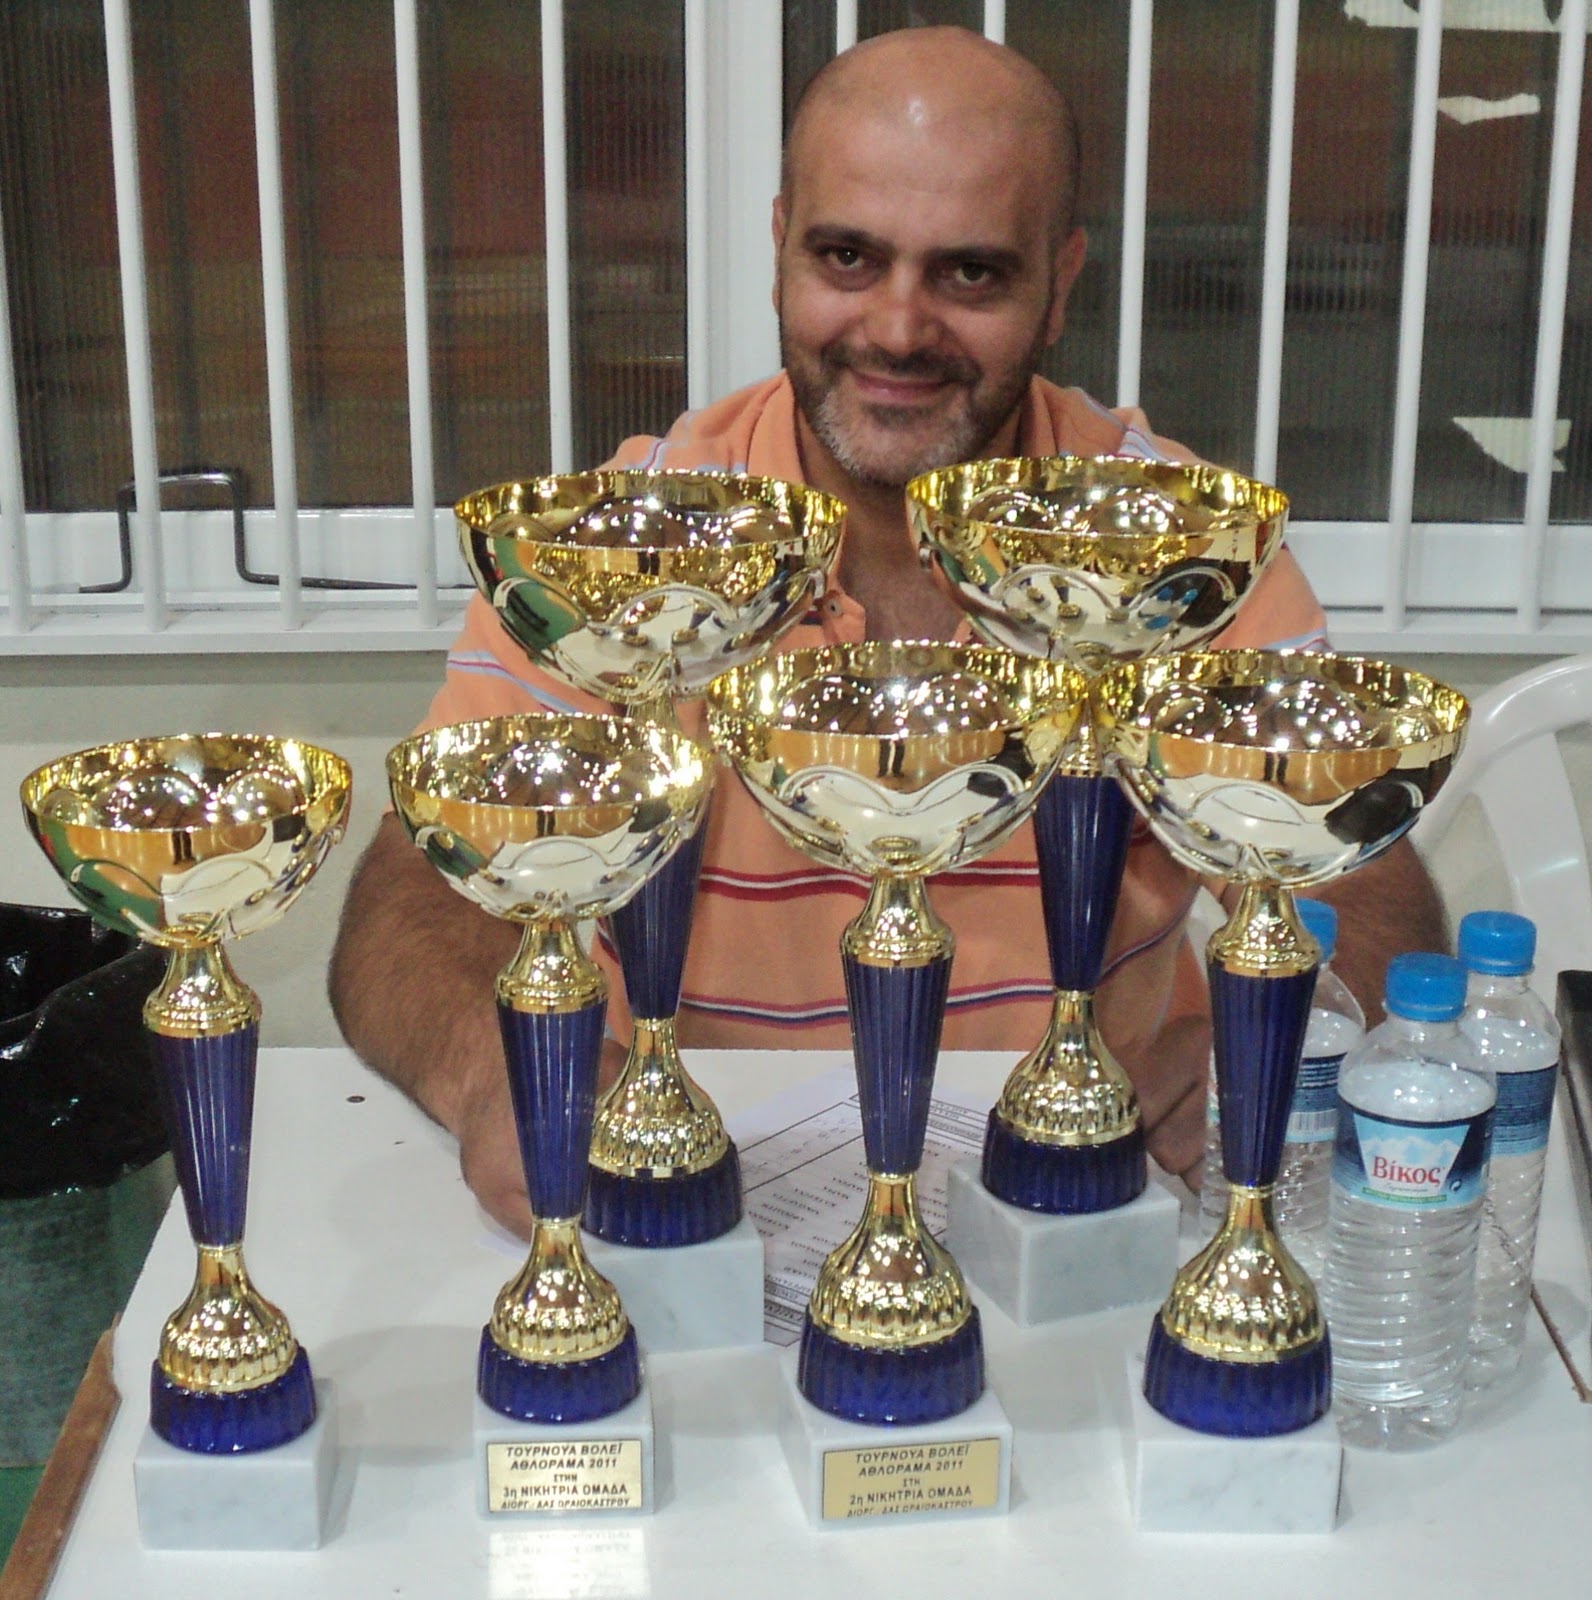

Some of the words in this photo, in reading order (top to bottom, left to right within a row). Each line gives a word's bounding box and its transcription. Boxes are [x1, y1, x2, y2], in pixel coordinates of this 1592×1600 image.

[1372, 1155, 1441, 1185] Βίκος
[507, 1444, 576, 1458] ΤΟΥΡΝΟΥΑ
[856, 1449, 924, 1464] ΤΟΥΡΝΟΥΑ
[511, 1458, 585, 1471] ΑΘΛΟΡΑΜΑ
[589, 1458, 617, 1469] 2011
[859, 1463, 931, 1477] ΑΘΛΟΡΑΜΑ
[936, 1460, 963, 1472] 2011
[521, 1485, 578, 1497] ΝΙΚΗΤΡΙΑ
[583, 1484, 628, 1495] ΟΜΑΔΑ
[867, 1489, 924, 1504] ΝΙΚΗΤΡΙΑ
[928, 1486, 971, 1498] ΟΜΑΔΑ
